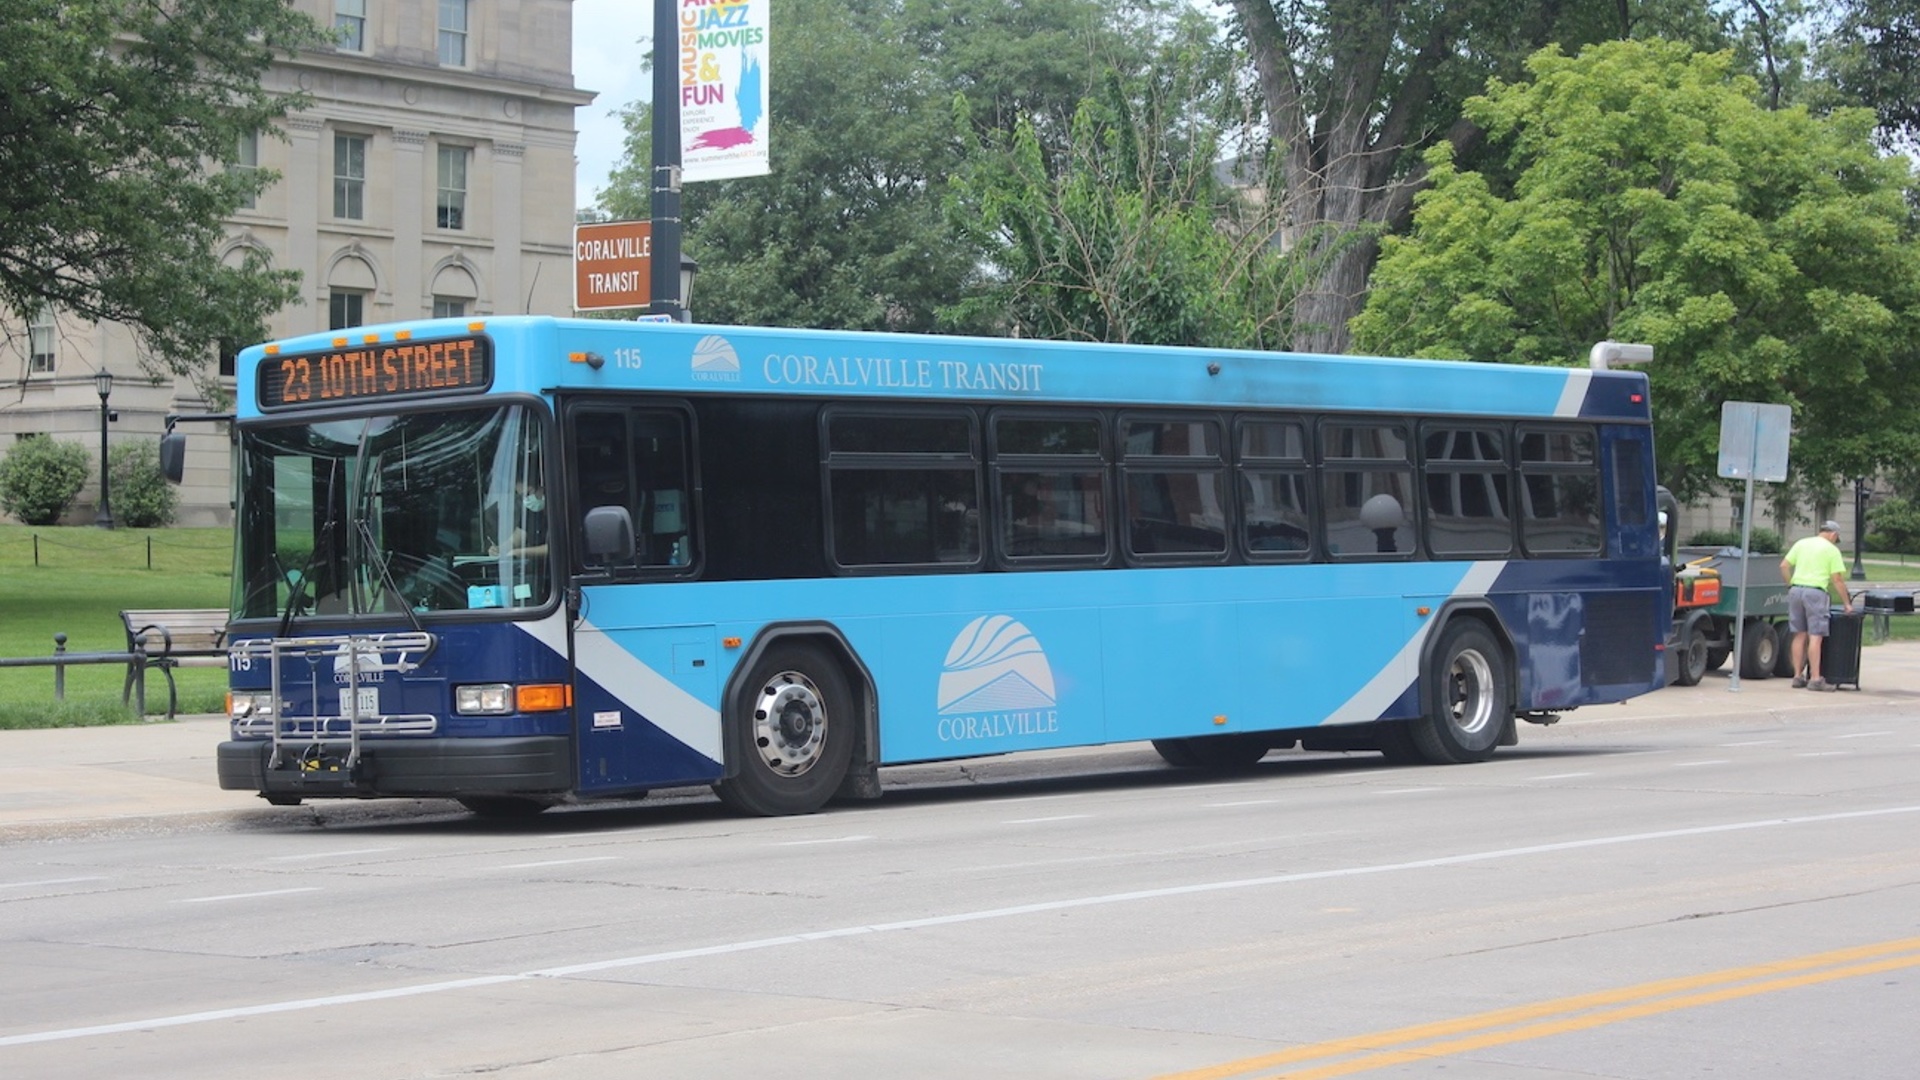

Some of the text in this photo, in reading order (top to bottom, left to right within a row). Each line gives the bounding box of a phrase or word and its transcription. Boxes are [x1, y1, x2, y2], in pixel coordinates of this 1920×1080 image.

[697, 4, 749, 31] JAZZ
[681, 10, 697, 86] MUSIC
[698, 27, 764, 50] MOVIES
[700, 53, 722, 82] &
[682, 84, 724, 107] FUN
[577, 236, 651, 262] CORALVILLE
[588, 271, 640, 294] TRANSIT
[280, 339, 475, 402] 23 10TH STREET
[614, 348, 642, 370] 115
[691, 371, 741, 383] CORALVILLE
[763, 353, 1044, 392] CORALVILLE TRANSIT
[230, 653, 252, 671] 115
[334, 672, 385, 684] CORLVILLE
[360, 694, 375, 710] 115
[937, 710, 1059, 742] CORALVILLE
